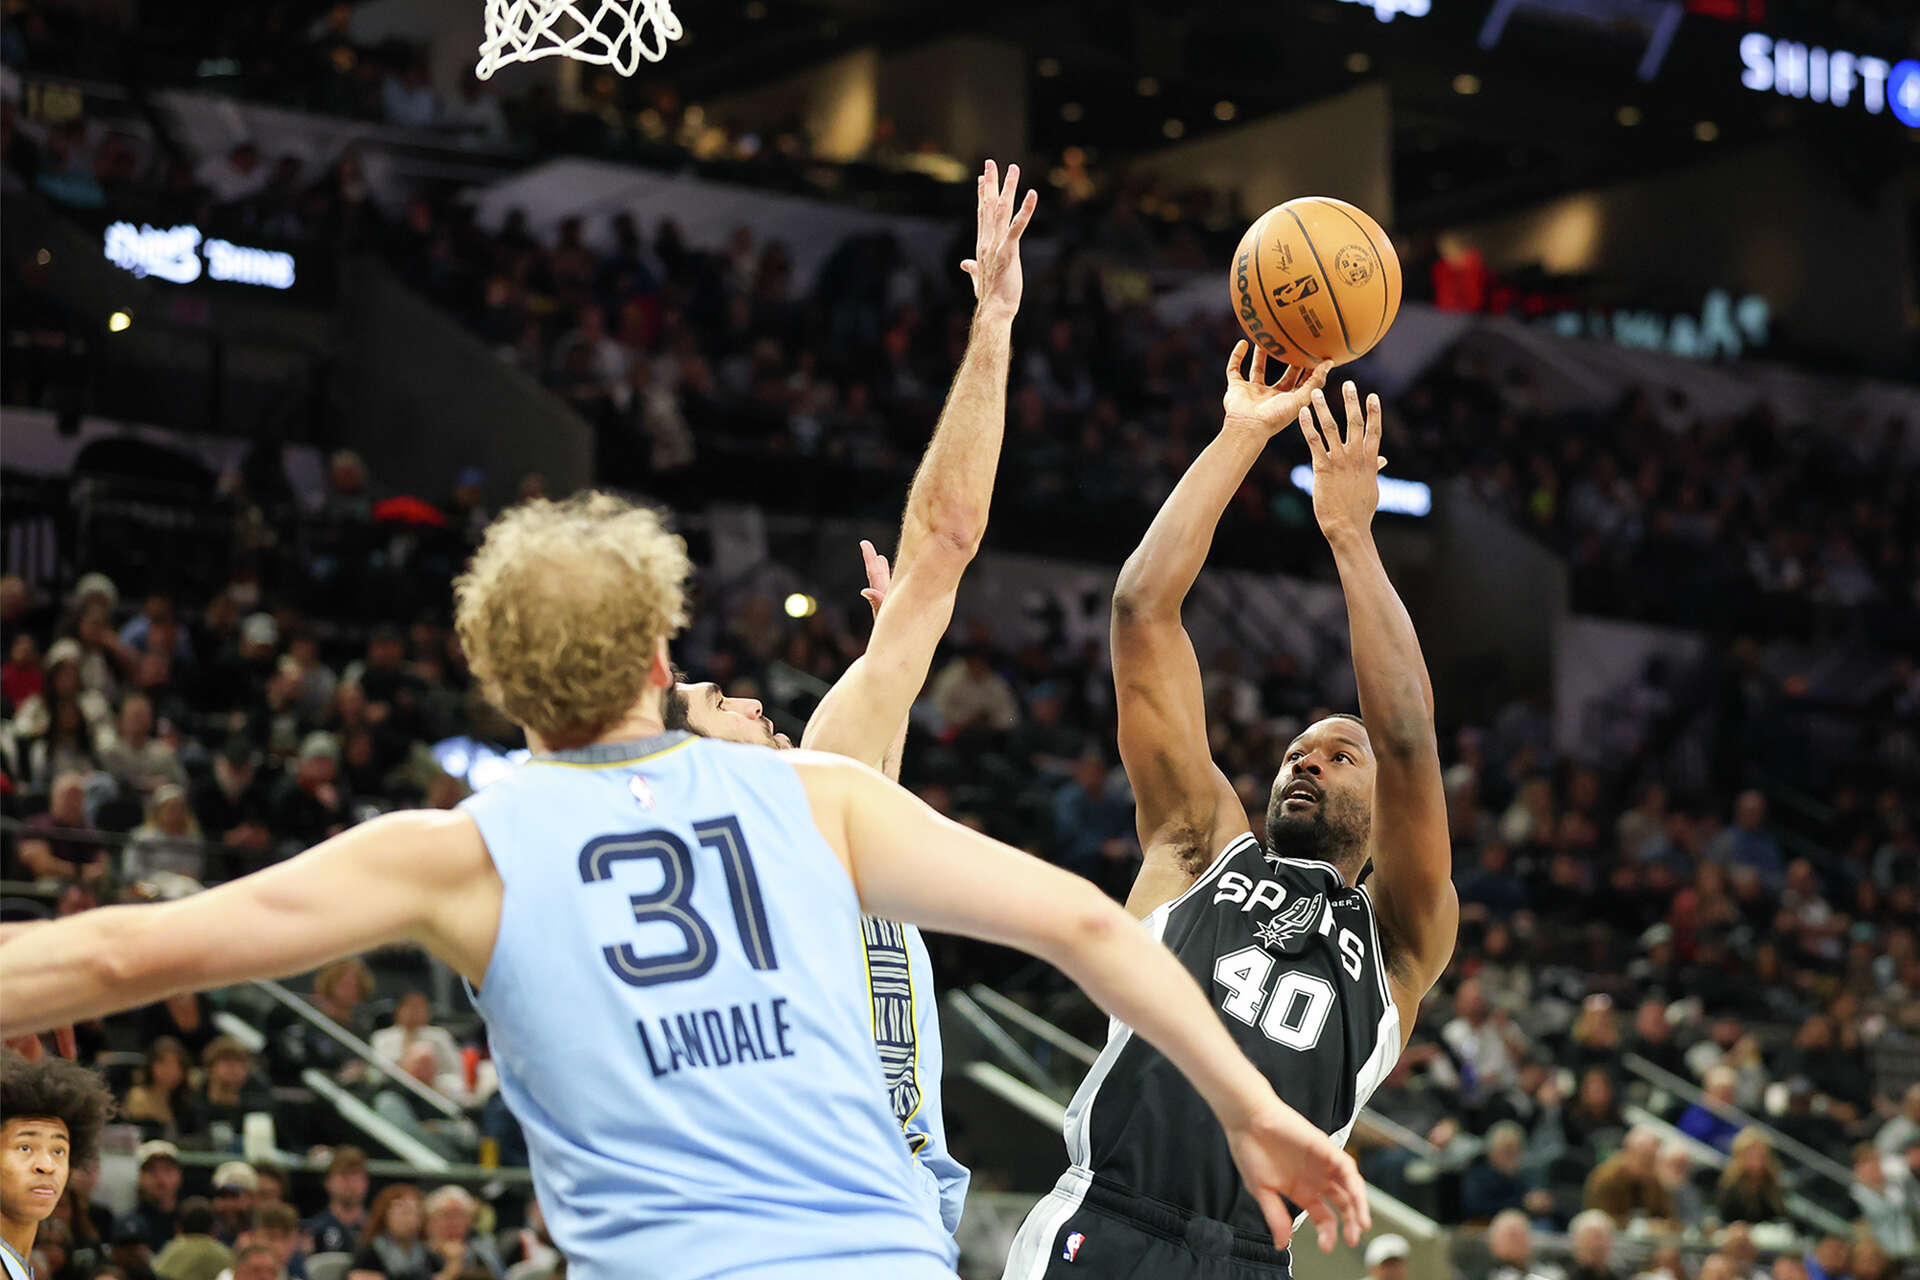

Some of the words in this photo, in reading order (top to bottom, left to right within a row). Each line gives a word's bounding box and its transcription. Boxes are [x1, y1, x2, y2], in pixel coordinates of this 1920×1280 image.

[578, 814, 779, 988] 31
[635, 997, 796, 1078] LANDALE
[1213, 944, 1337, 1052] 40
